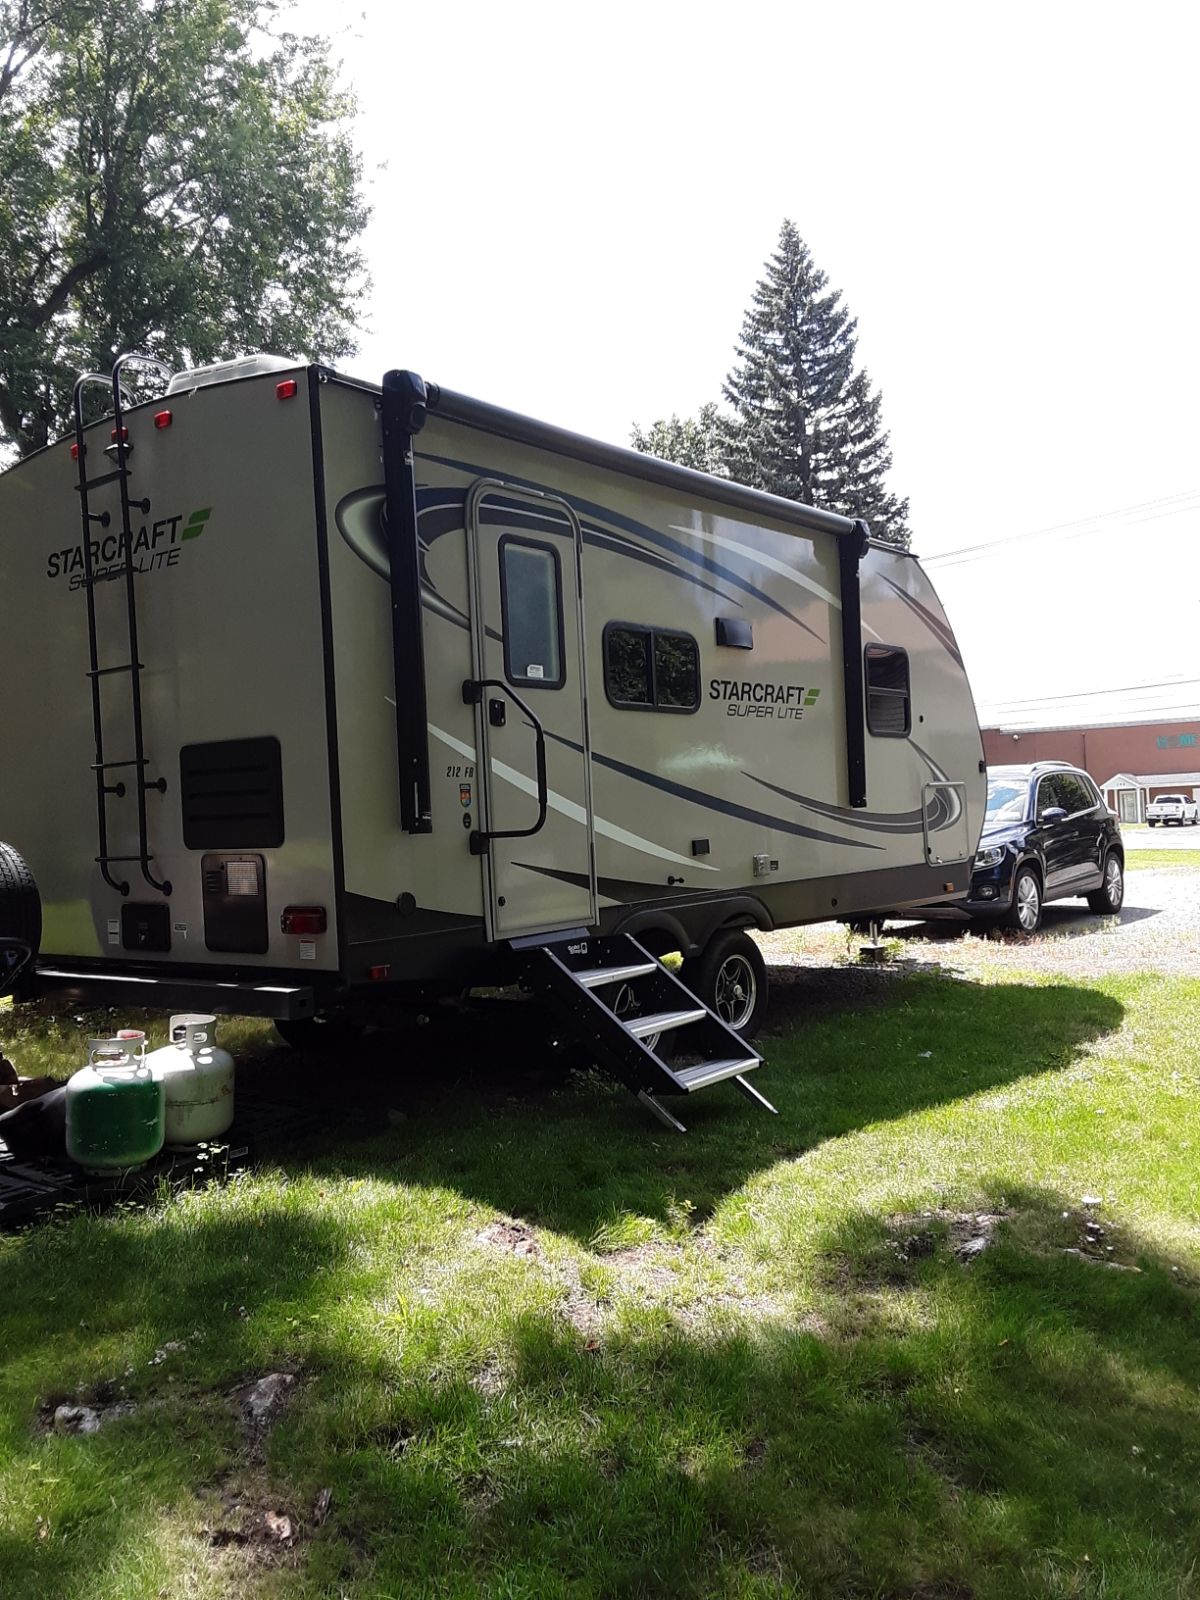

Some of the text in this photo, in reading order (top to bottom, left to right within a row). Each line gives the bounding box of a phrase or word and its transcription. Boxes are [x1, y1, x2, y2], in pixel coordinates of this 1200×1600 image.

[47, 514, 183, 578] STARCRAFT
[138, 547, 182, 574] LITE
[709, 679, 804, 705] STARCRAFT
[727, 704, 804, 720] SUPER LITE
[446, 766, 461, 778] 212
